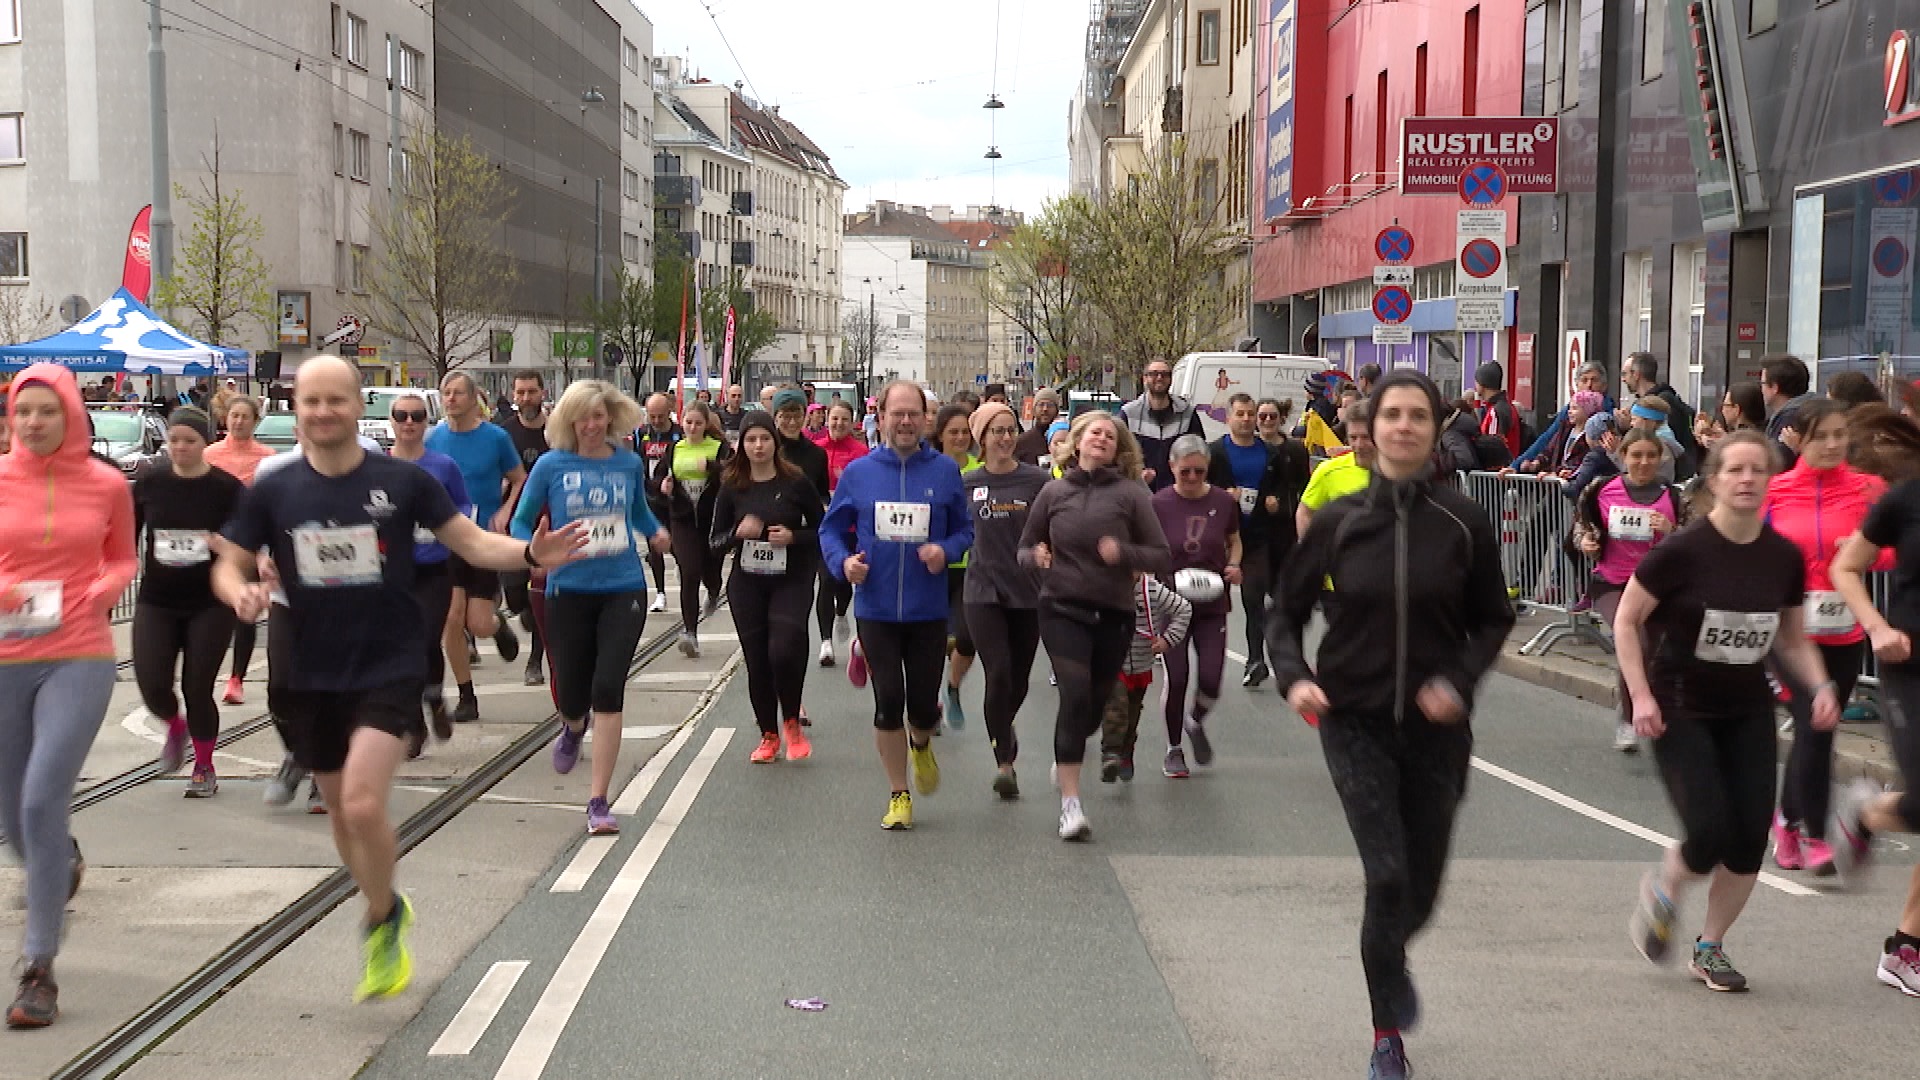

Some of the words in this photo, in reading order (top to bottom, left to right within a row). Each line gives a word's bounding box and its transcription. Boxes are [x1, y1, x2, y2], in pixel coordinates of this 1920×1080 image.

[1408, 133, 1535, 155] RUSTLER
[1407, 157, 1436, 167] REAL
[1274, 367, 1309, 381] ATLA
[889, 511, 913, 527] 471
[1619, 515, 1641, 527] 444
[752, 549, 774, 561] 428
[1704, 627, 1771, 649] 52603
